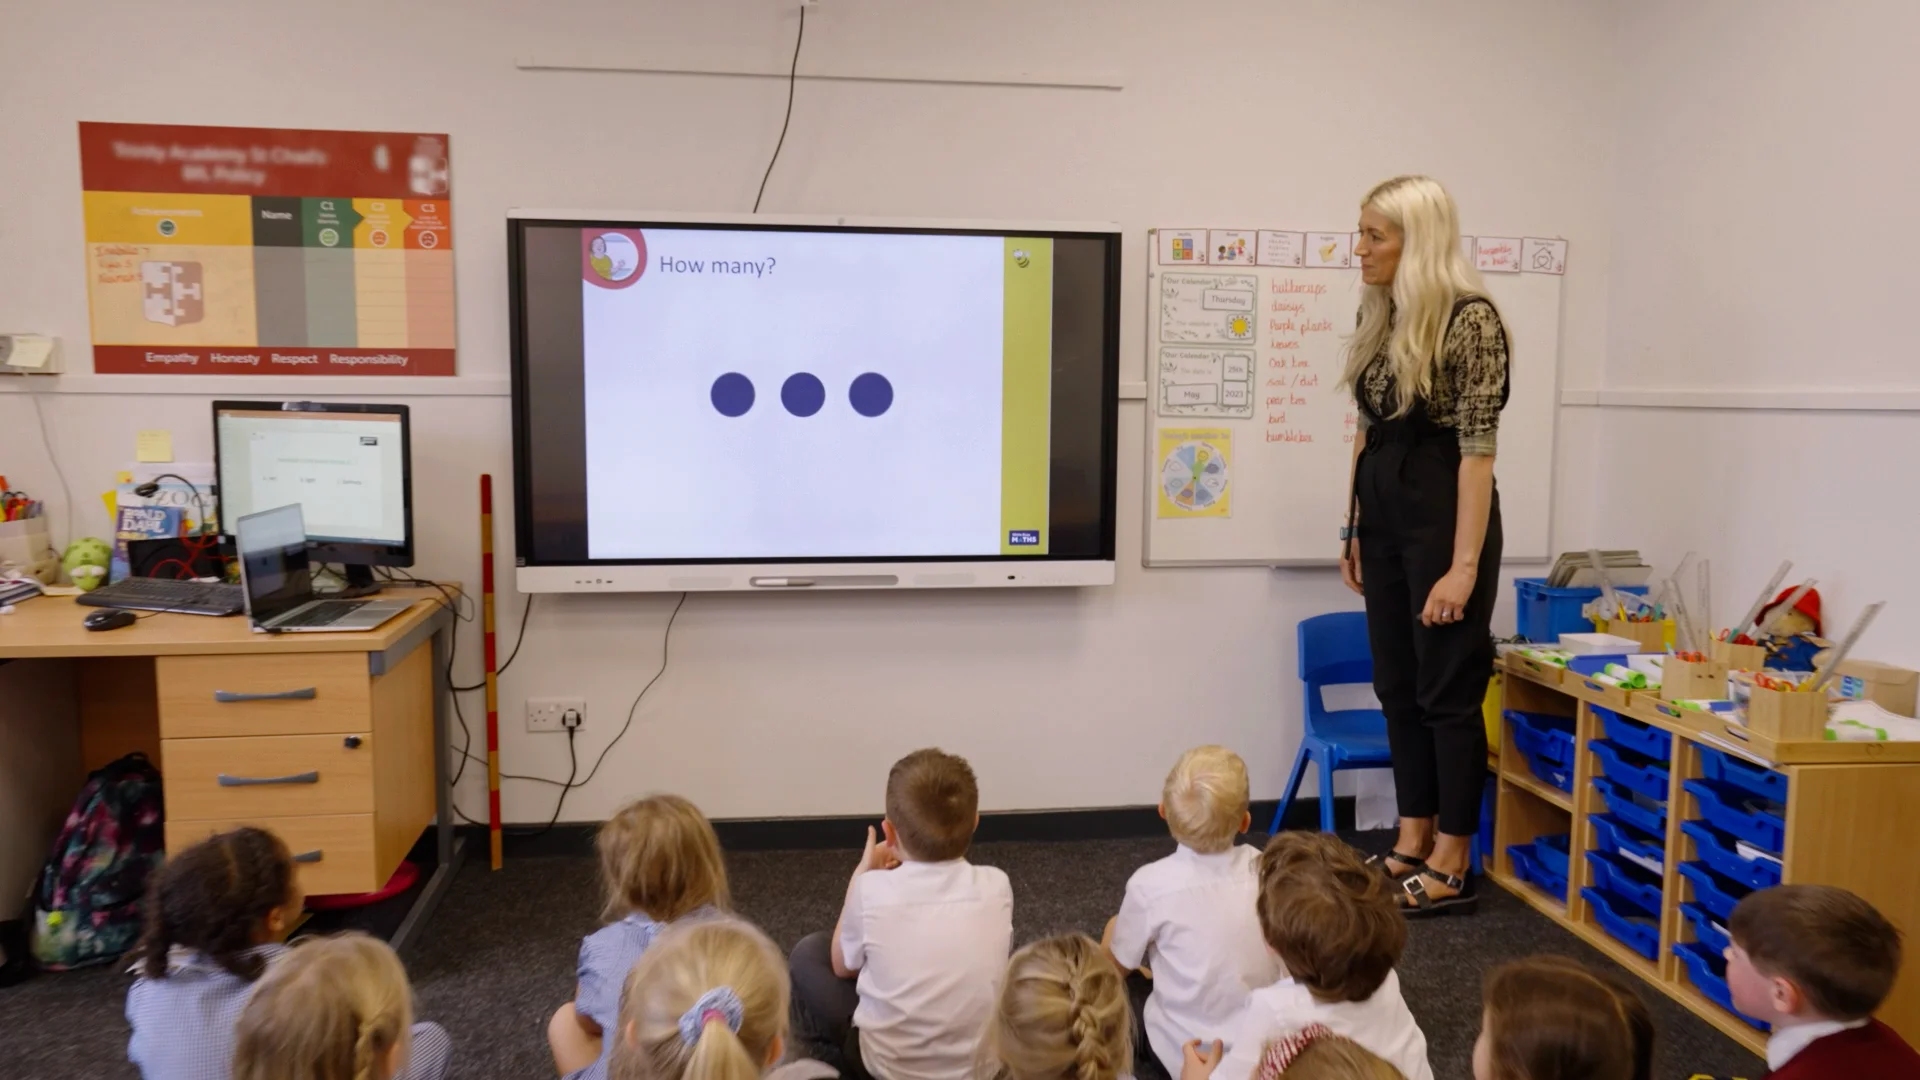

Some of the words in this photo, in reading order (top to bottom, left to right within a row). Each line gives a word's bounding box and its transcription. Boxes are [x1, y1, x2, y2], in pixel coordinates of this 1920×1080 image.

[320, 201, 335, 211] C1
[261, 209, 293, 221] Name
[660, 256, 705, 274] How
[712, 257, 776, 279] many?
[1211, 295, 1246, 306] Thursday
[146, 352, 199, 366] Empathy
[210, 353, 260, 366] Honesty
[271, 353, 319, 366] Respect
[329, 353, 409, 367] Responsibility
[1227, 366, 1244, 374] 25th
[1183, 391, 1200, 401] May
[1225, 389, 1244, 398] 2023
[122, 519, 165, 534] DAHL
